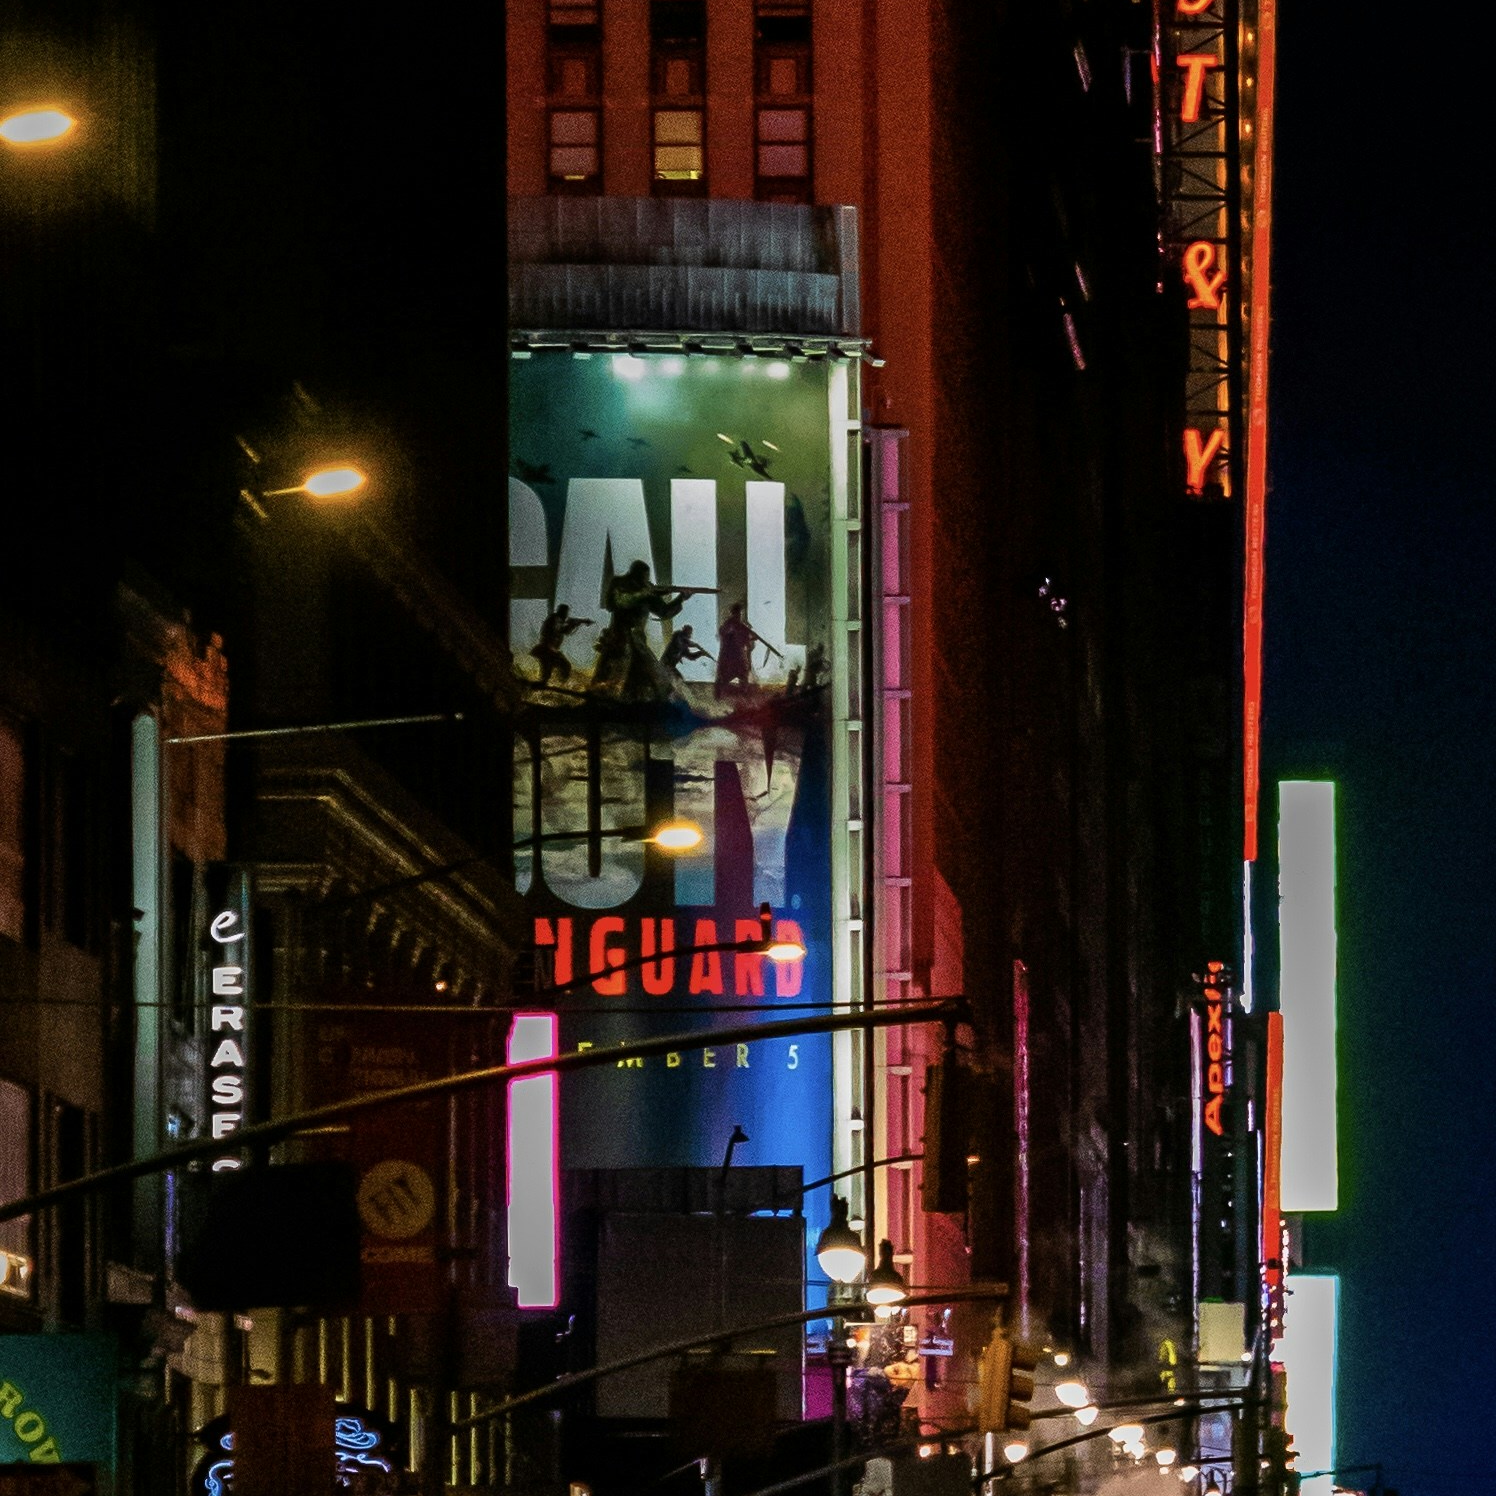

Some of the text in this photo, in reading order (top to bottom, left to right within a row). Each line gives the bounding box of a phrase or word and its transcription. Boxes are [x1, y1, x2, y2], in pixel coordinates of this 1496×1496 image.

[1183, 238, 1226, 310] &
[514, 722, 803, 910] UTY
[786, 1043, 800, 1070] 5
